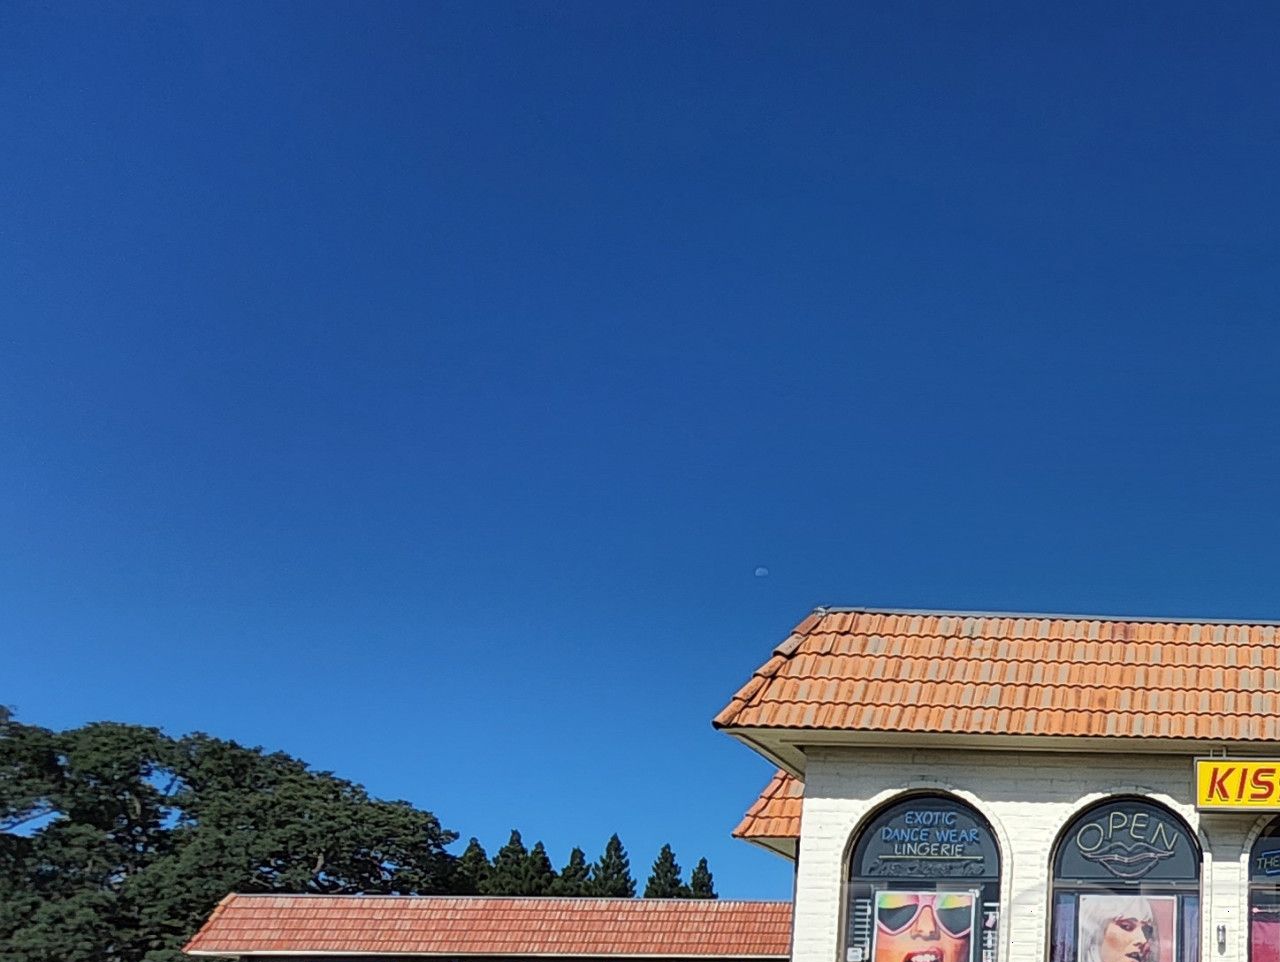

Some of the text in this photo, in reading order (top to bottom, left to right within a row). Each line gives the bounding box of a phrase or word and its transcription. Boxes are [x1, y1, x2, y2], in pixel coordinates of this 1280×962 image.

[905, 811, 957, 825] EXOTIC
[882, 827, 980, 843] DANCE WEAR
[1077, 811, 1179, 851] OPEN
[894, 842, 964, 857] LINGERIE
[1256, 857, 1280, 870] THE
